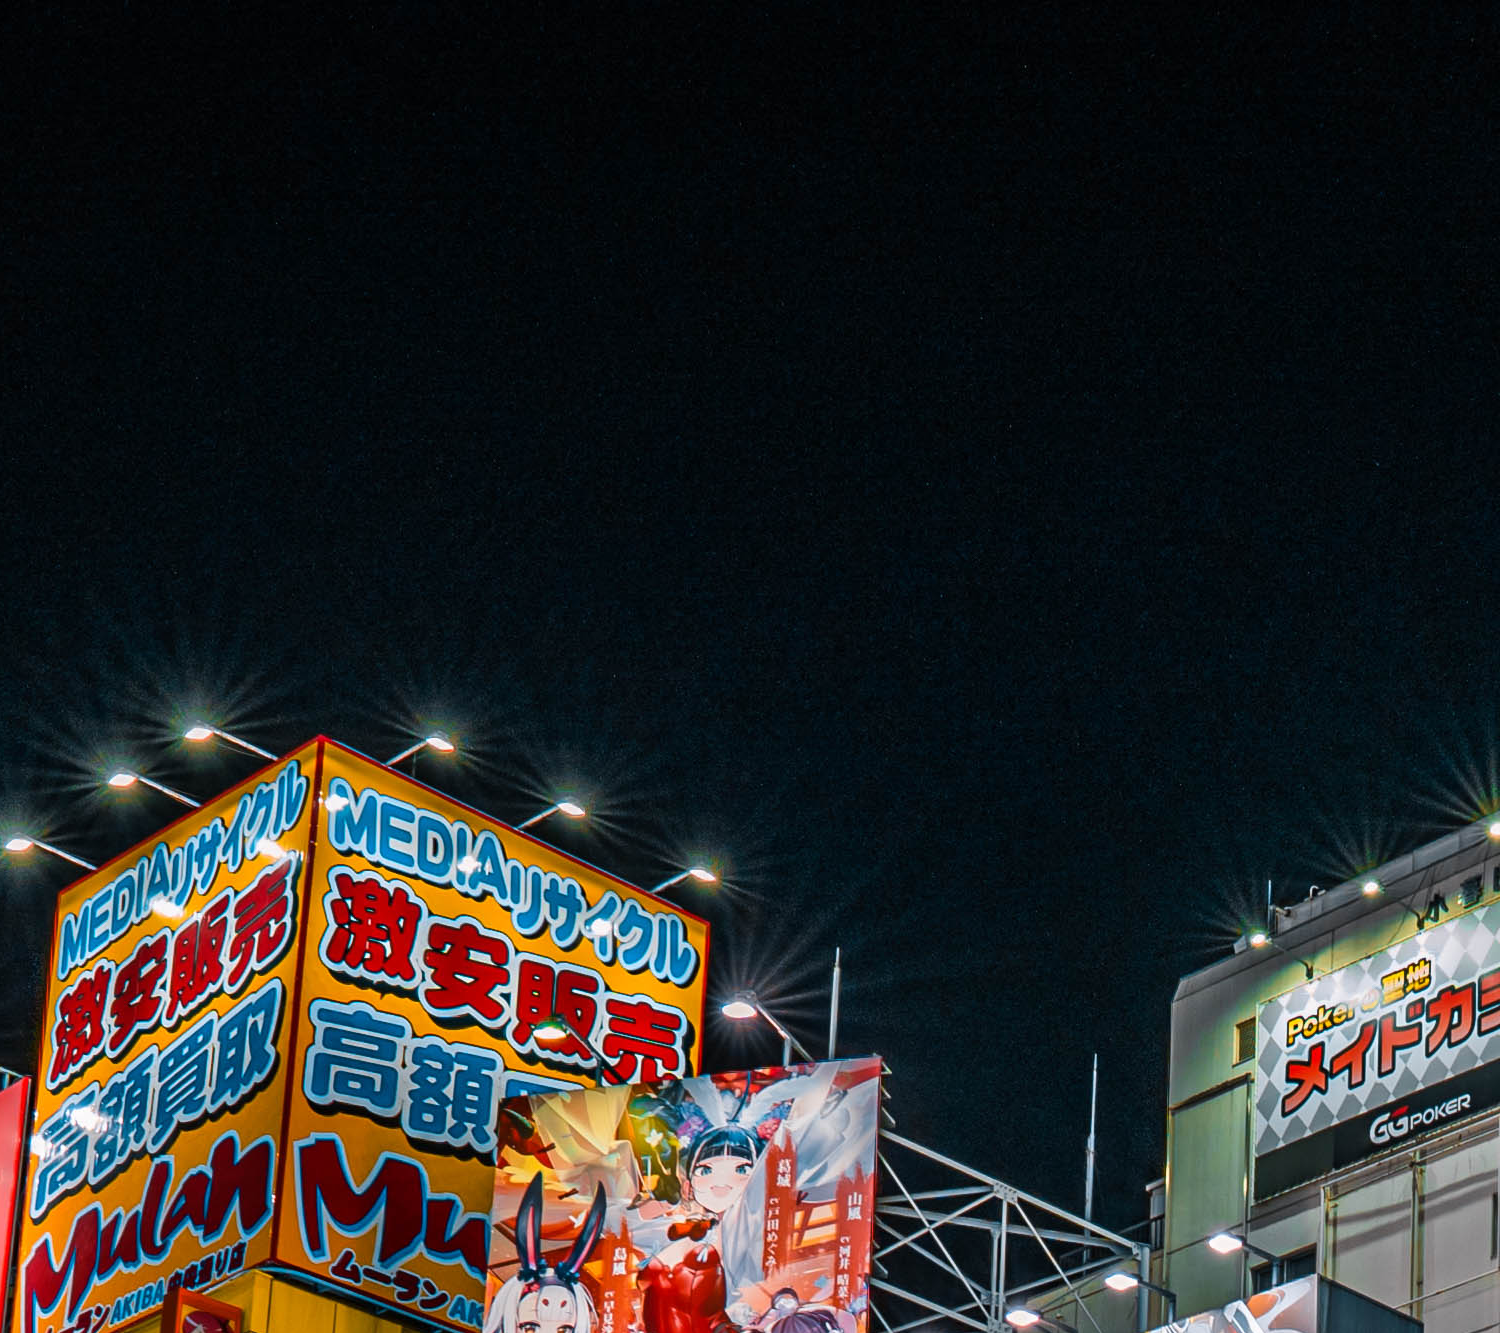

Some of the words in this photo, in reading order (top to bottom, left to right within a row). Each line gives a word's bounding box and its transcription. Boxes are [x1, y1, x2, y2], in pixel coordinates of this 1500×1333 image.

[46, 855, 297, 1090] 激安販売
[320, 866, 688, 1086] 激安販売
[33, 975, 286, 1218] 高額買取
[110, 1279, 165, 1327] AKIBA
[329, 1249, 449, 1312] ムーラン
